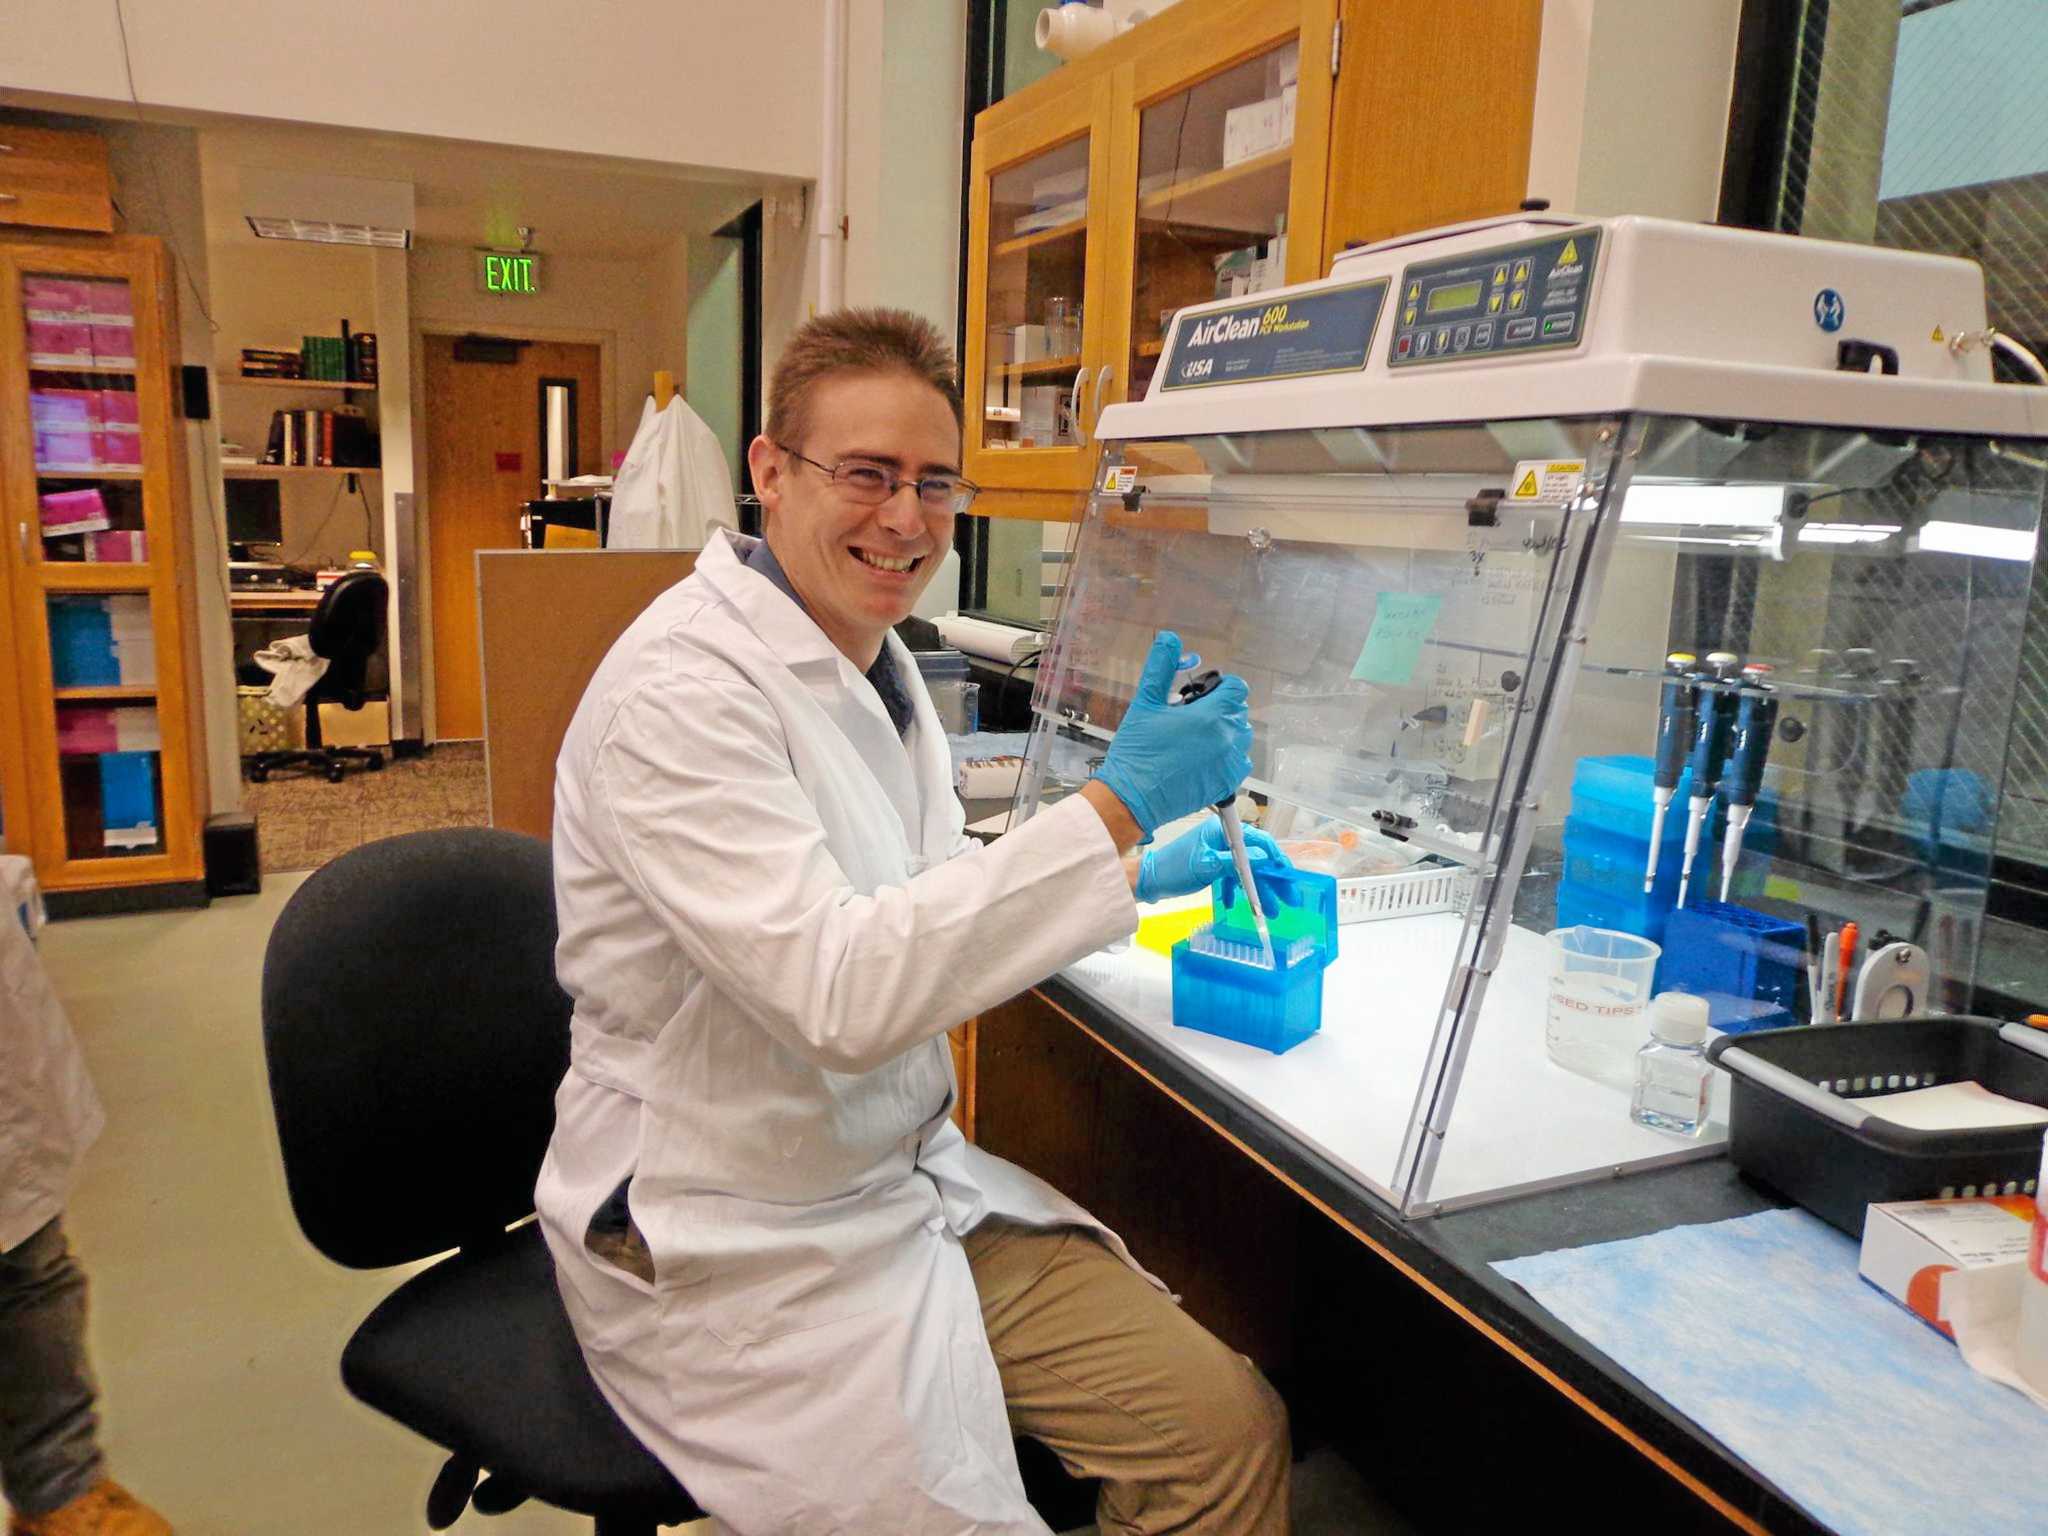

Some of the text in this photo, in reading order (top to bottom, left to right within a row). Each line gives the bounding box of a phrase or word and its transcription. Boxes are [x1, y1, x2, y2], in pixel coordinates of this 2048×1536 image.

[486, 256, 532, 291] EXIT
[1186, 304, 1288, 348] AirClean 600
[1186, 358, 1214, 377] USA
